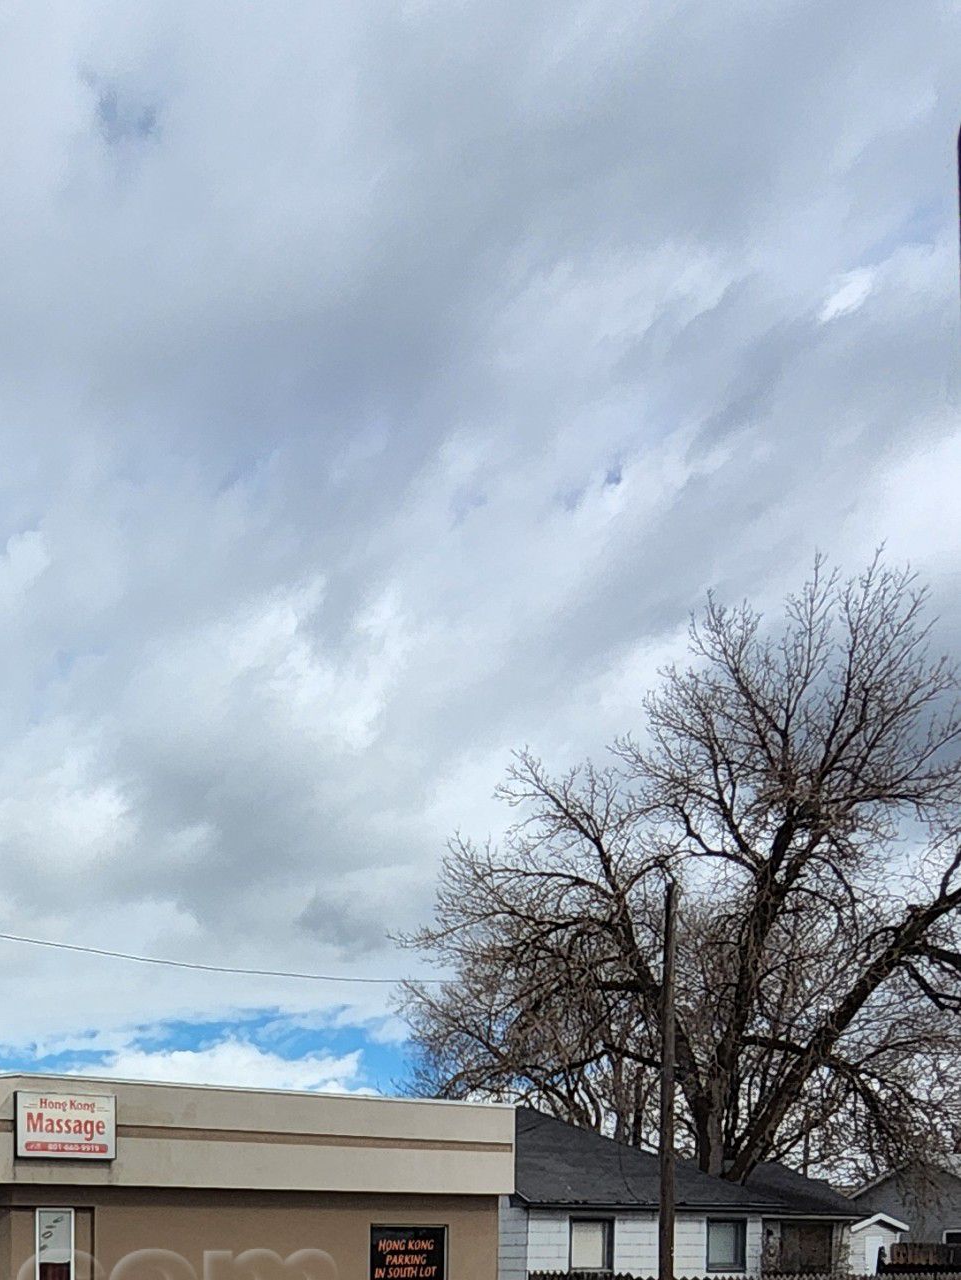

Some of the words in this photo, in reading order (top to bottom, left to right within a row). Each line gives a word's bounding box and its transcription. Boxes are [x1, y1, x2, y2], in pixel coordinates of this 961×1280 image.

[39, 1098, 67, 1112] Hong
[69, 1100, 95, 1113] Kong
[26, 1112, 105, 1141] Massage
[378, 1239, 406, 1251] HONG
[408, 1239, 435, 1250] KONG
[385, 1254, 427, 1265] PARKING
[374, 1267, 385, 1279] IN
[387, 1267, 417, 1278] SOUTH
[419, 1266, 437, 1278] LOT
